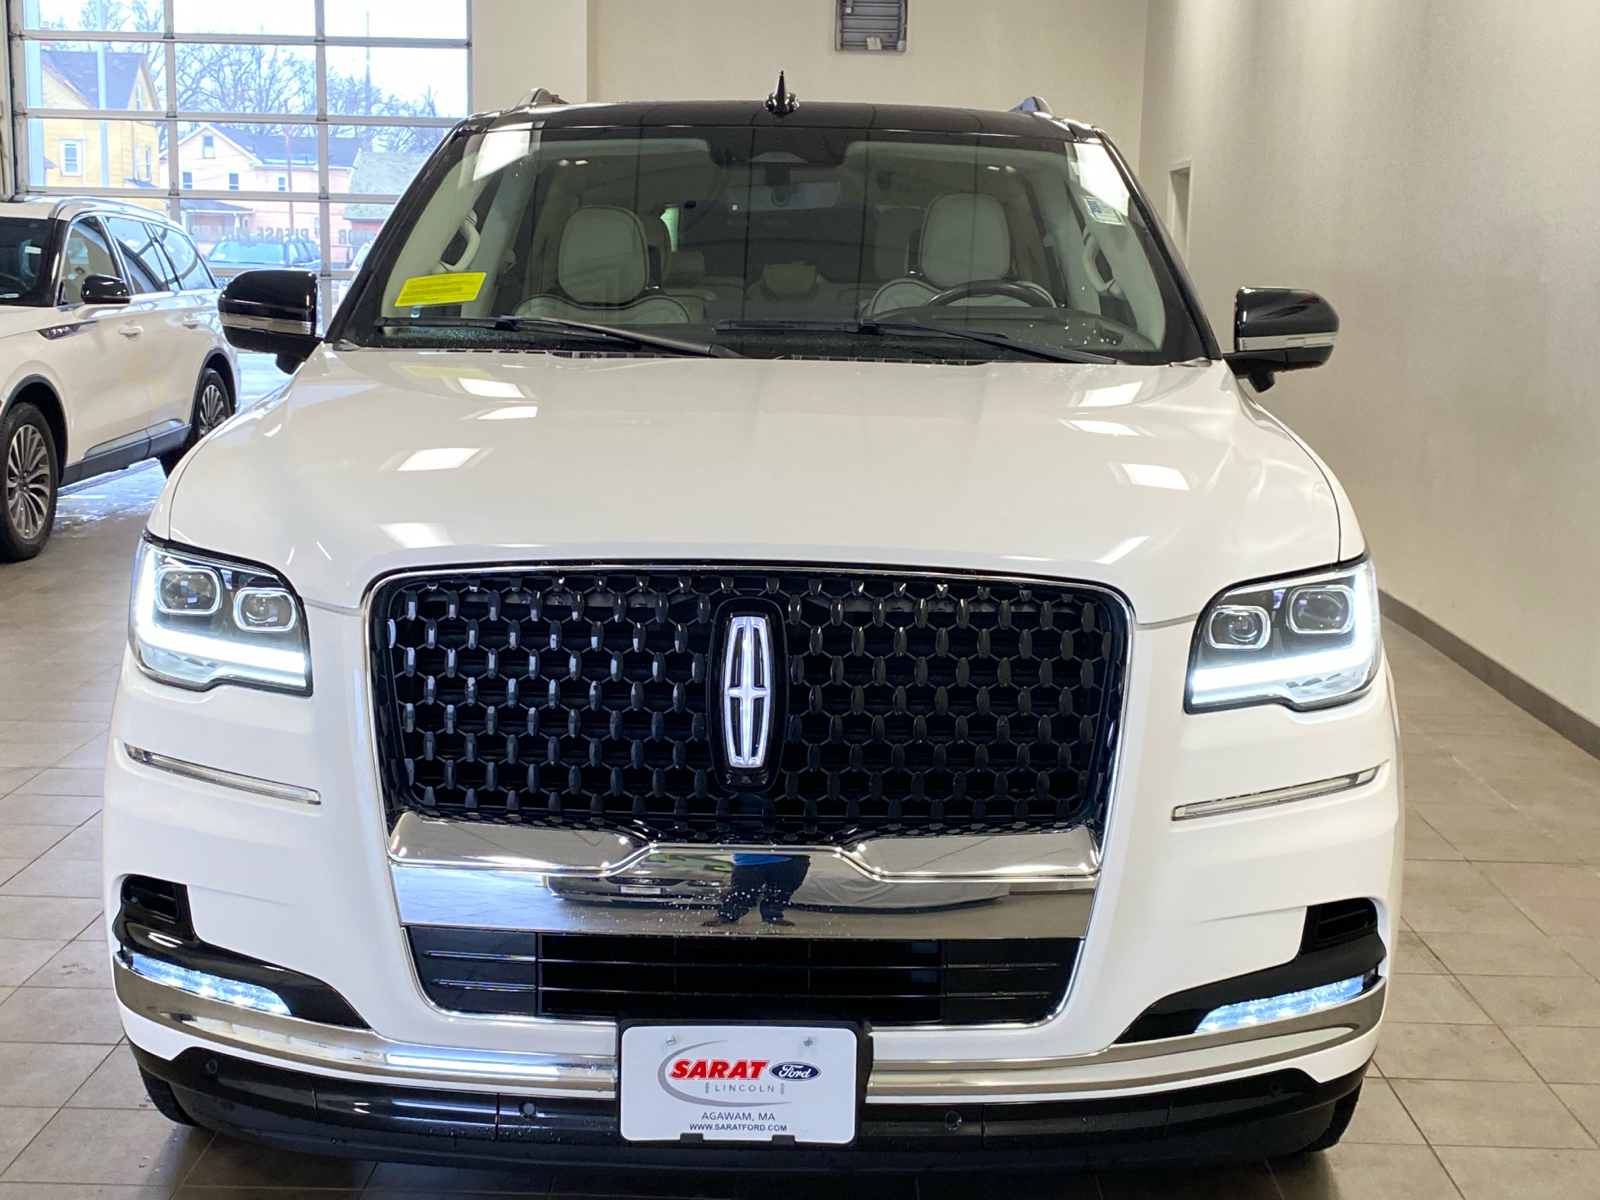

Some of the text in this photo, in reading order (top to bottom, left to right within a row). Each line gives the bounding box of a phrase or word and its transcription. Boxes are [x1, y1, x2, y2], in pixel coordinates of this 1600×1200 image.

[669, 1058, 812, 1080] SARAT Ford
[715, 1084, 774, 1093] LINCOLN
[701, 1111, 776, 1122] AGAWAM, MA
[689, 1123, 787, 1132] WWW.SARATFORD.COM
